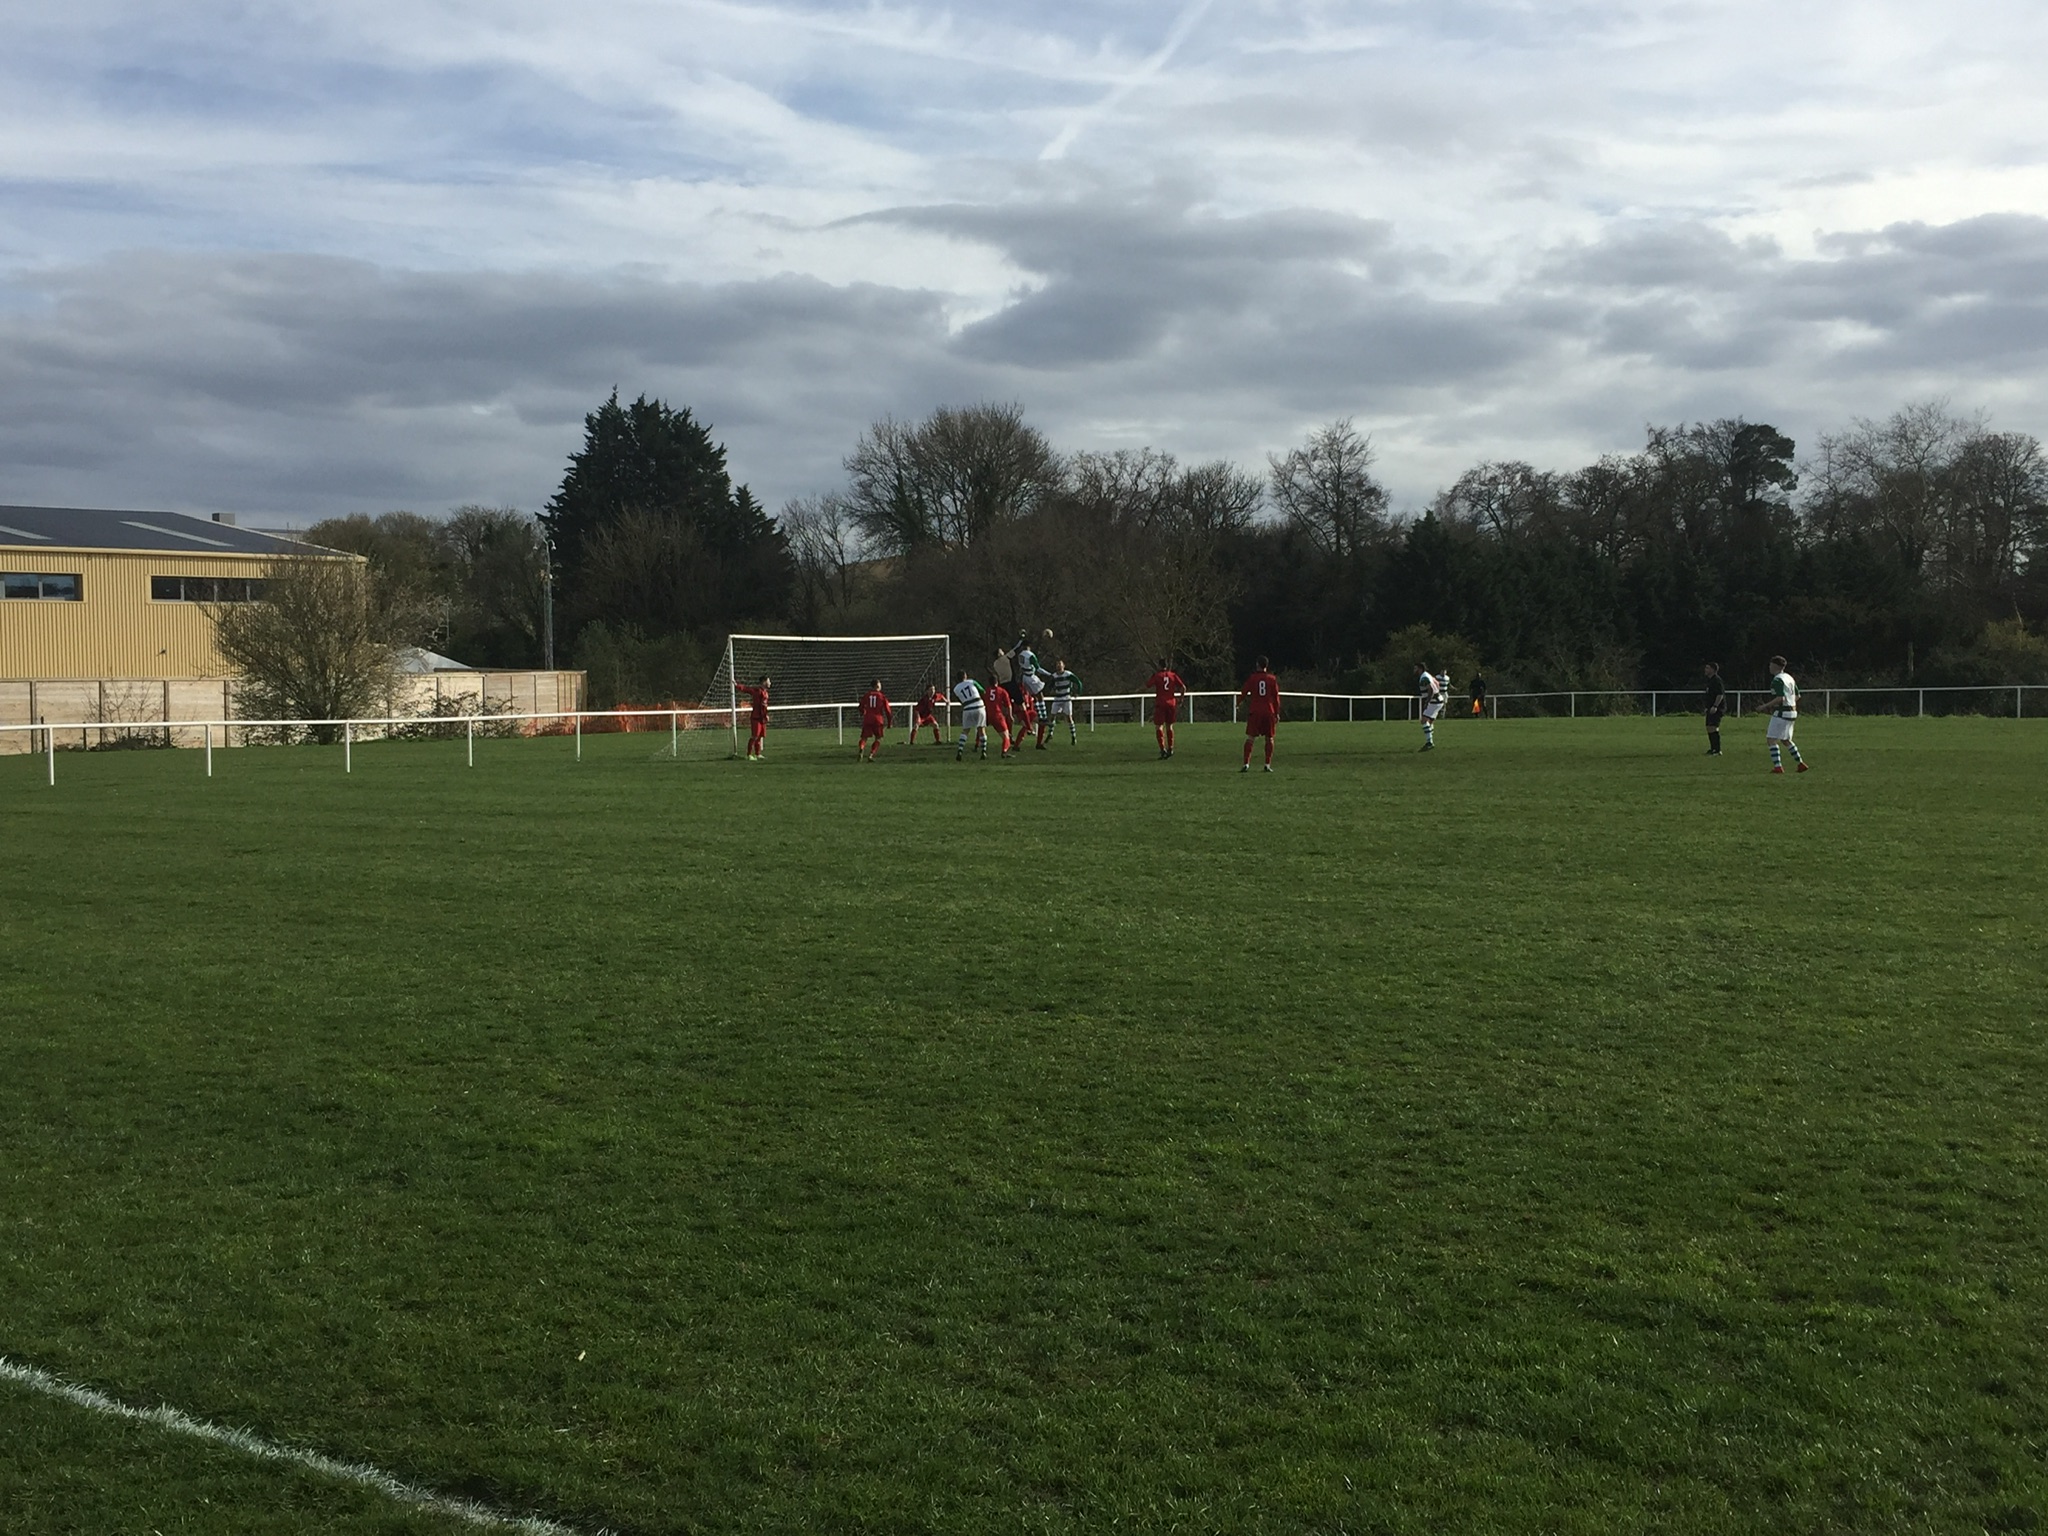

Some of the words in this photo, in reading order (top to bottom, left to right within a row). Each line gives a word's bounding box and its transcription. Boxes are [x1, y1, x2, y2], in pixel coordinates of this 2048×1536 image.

[1163, 676, 1169, 690] 2
[1258, 680, 1266, 696] 8
[960, 685, 973, 699] 17
[989, 689, 996, 701] 5
[869, 695, 877, 708] 11
